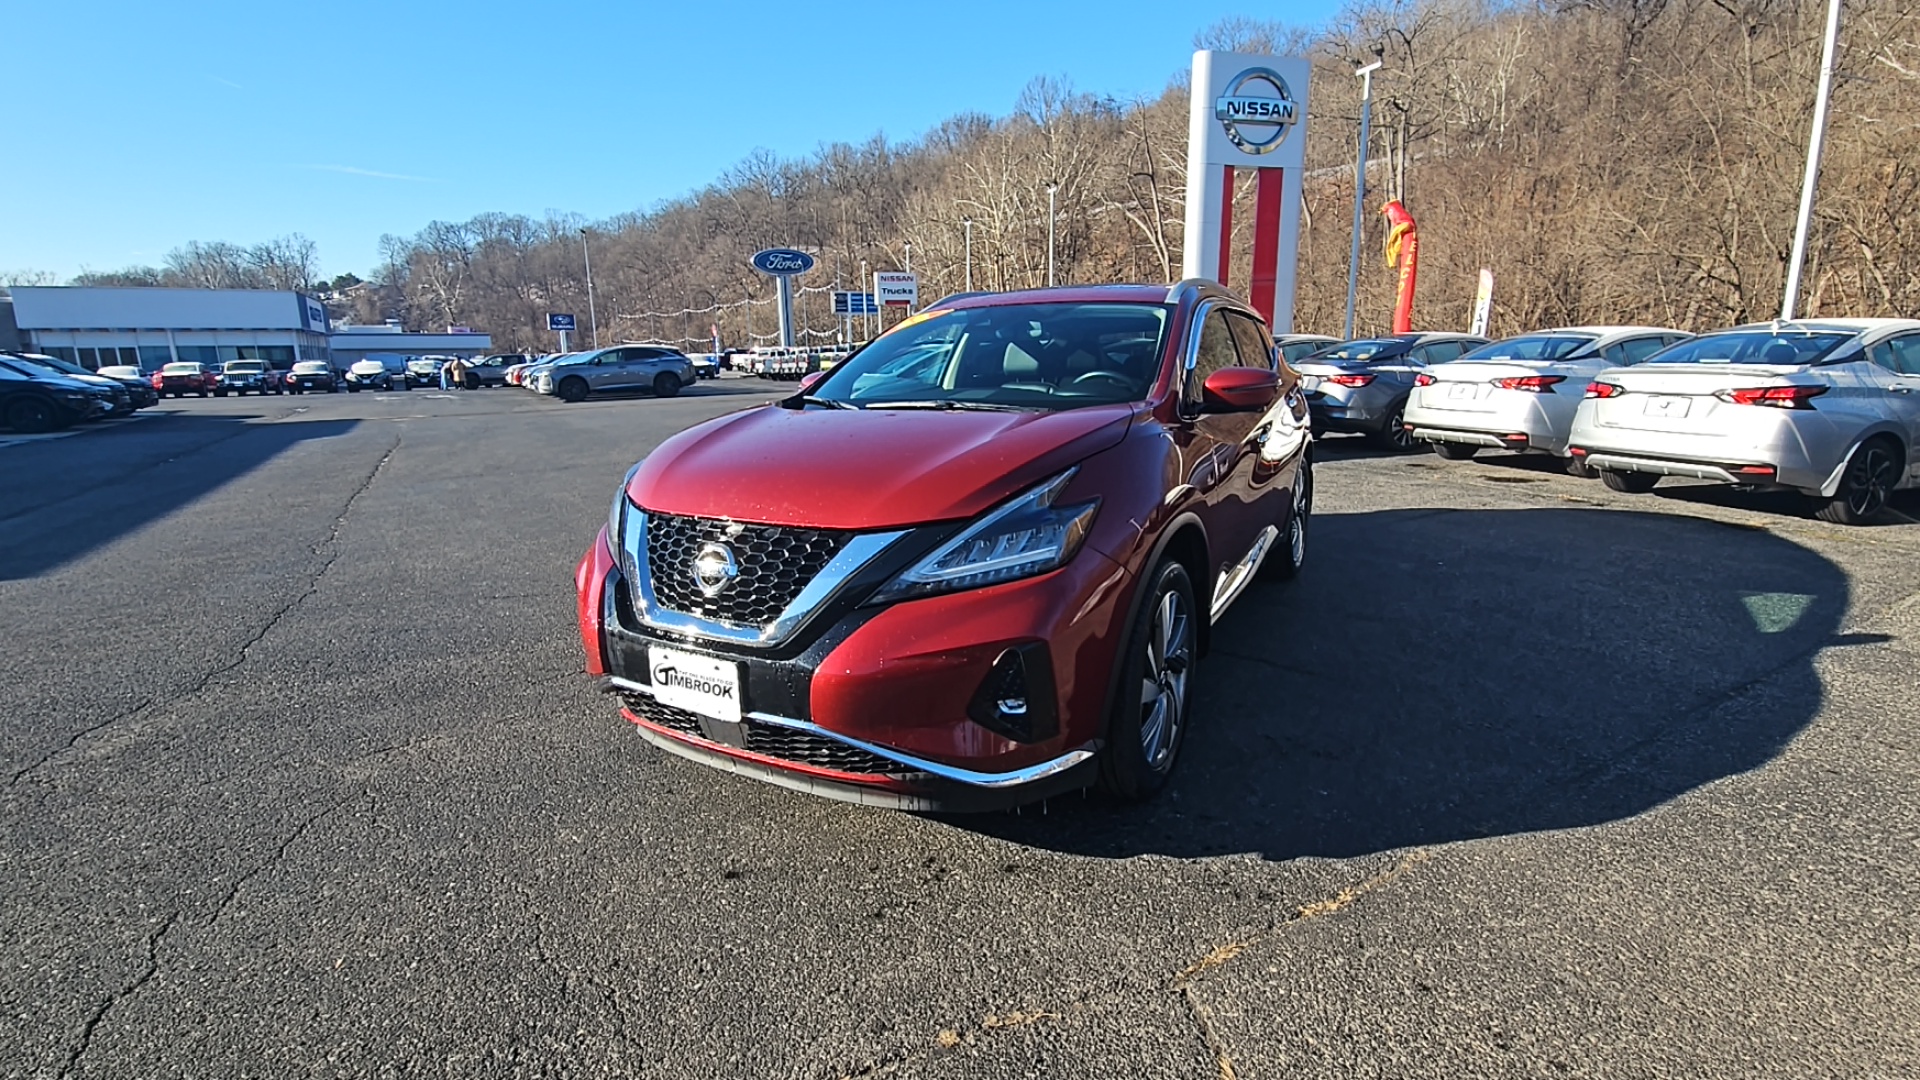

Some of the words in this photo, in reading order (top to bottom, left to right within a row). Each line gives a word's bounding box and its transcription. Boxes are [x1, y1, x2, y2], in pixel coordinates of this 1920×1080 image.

[1226, 101, 1292, 118] NISSAN
[766, 253, 802, 270] Ford
[881, 287, 914, 295] Trucks
